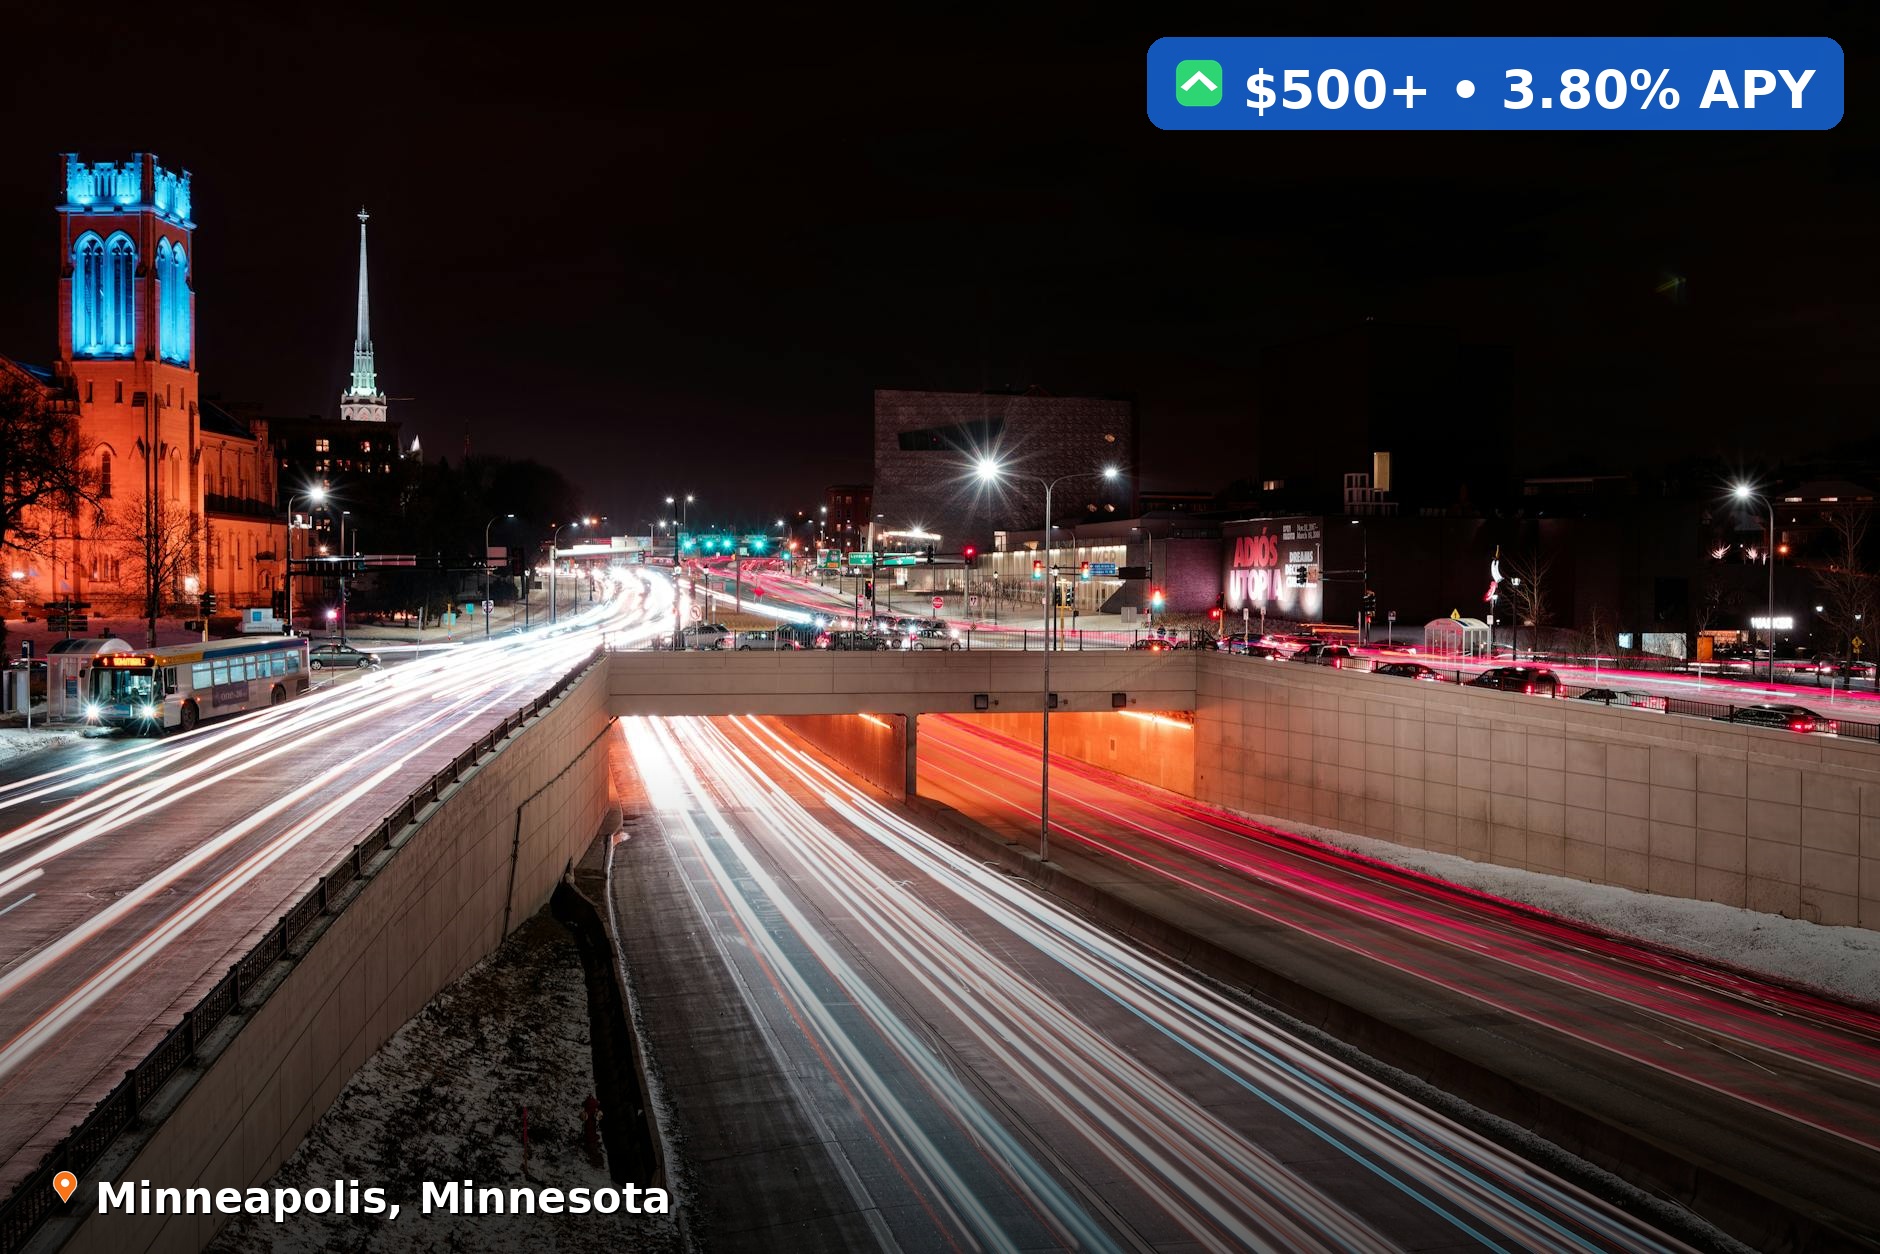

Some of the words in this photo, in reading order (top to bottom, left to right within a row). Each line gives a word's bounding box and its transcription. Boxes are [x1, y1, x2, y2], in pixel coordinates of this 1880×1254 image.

[1234, 527, 1278, 567] ADIÓS
[1289, 551, 1313, 563] DREAMS
[1230, 569, 1283, 601] UTOPIA
